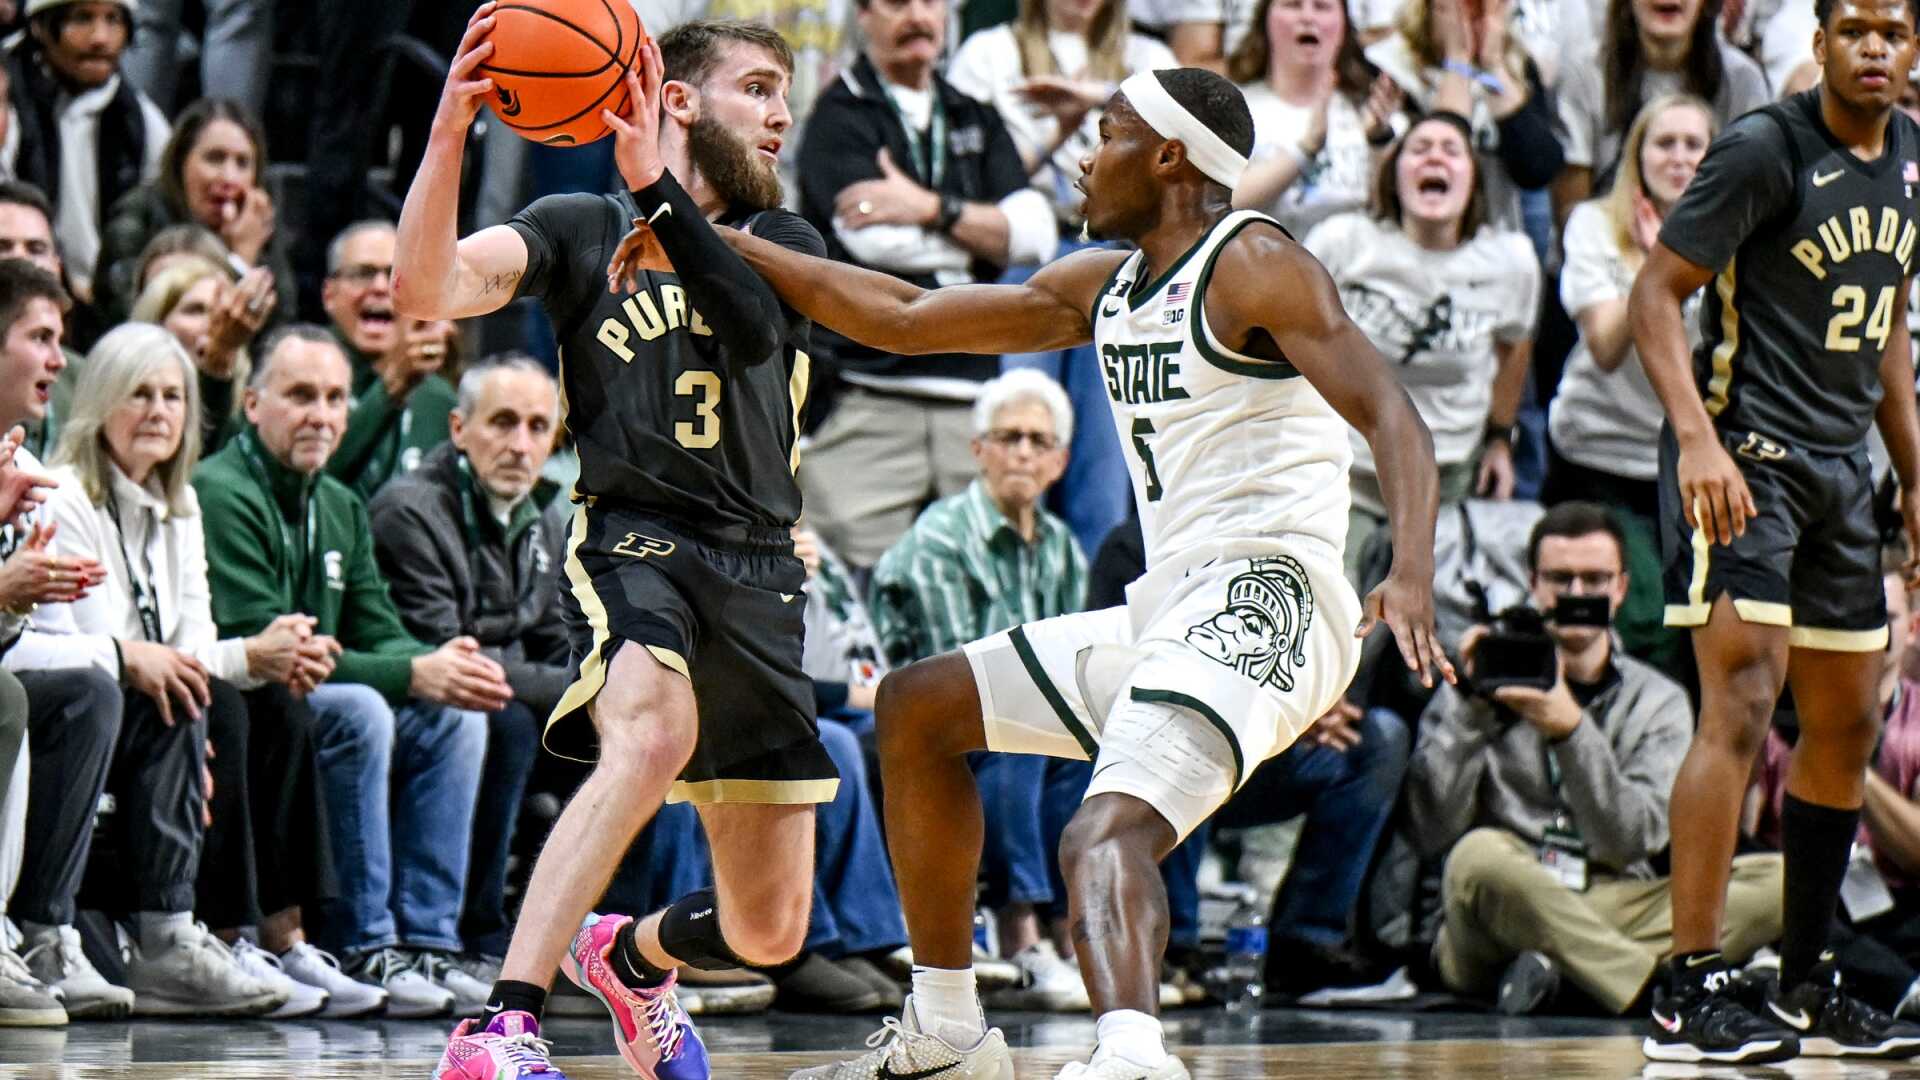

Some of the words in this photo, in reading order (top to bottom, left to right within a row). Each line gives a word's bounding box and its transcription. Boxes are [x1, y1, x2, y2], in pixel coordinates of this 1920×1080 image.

[1790, 205, 1917, 280] PURDU
[1825, 285, 1896, 352] 24
[1102, 340, 1191, 404] STATE
[674, 370, 721, 449] 3
[1131, 417, 1164, 502] 5
[612, 532, 676, 558] P
